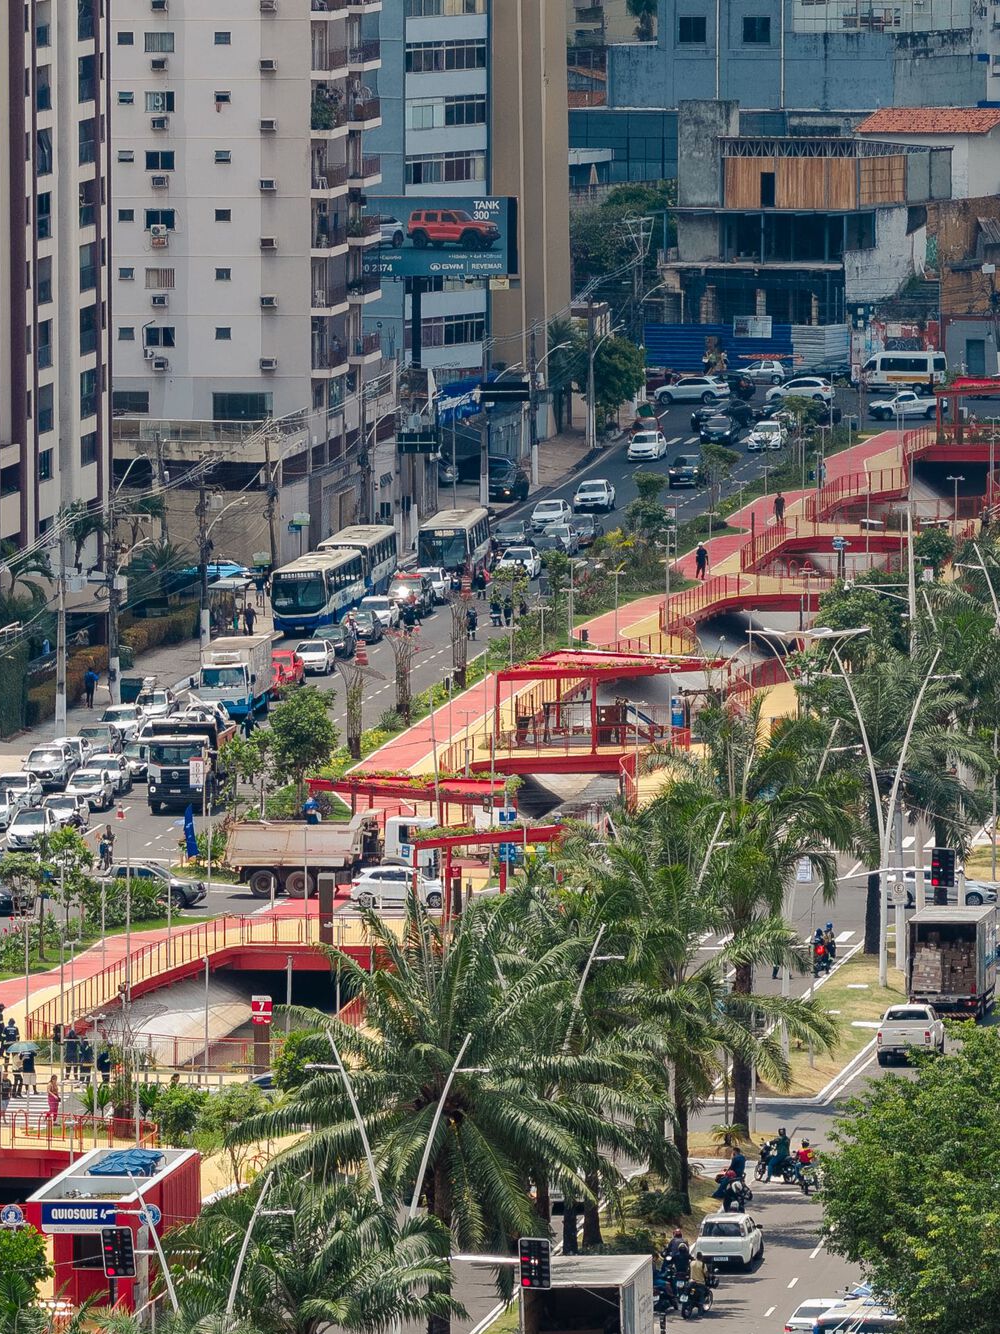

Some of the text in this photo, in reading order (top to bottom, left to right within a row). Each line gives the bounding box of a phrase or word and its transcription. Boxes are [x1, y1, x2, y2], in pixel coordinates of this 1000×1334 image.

[473, 200, 500, 210] TANK
[473, 210, 490, 220] 300
[258, 1001, 265, 1011] 7
[51, 1208, 107, 1220] QUIOSQUE 4
